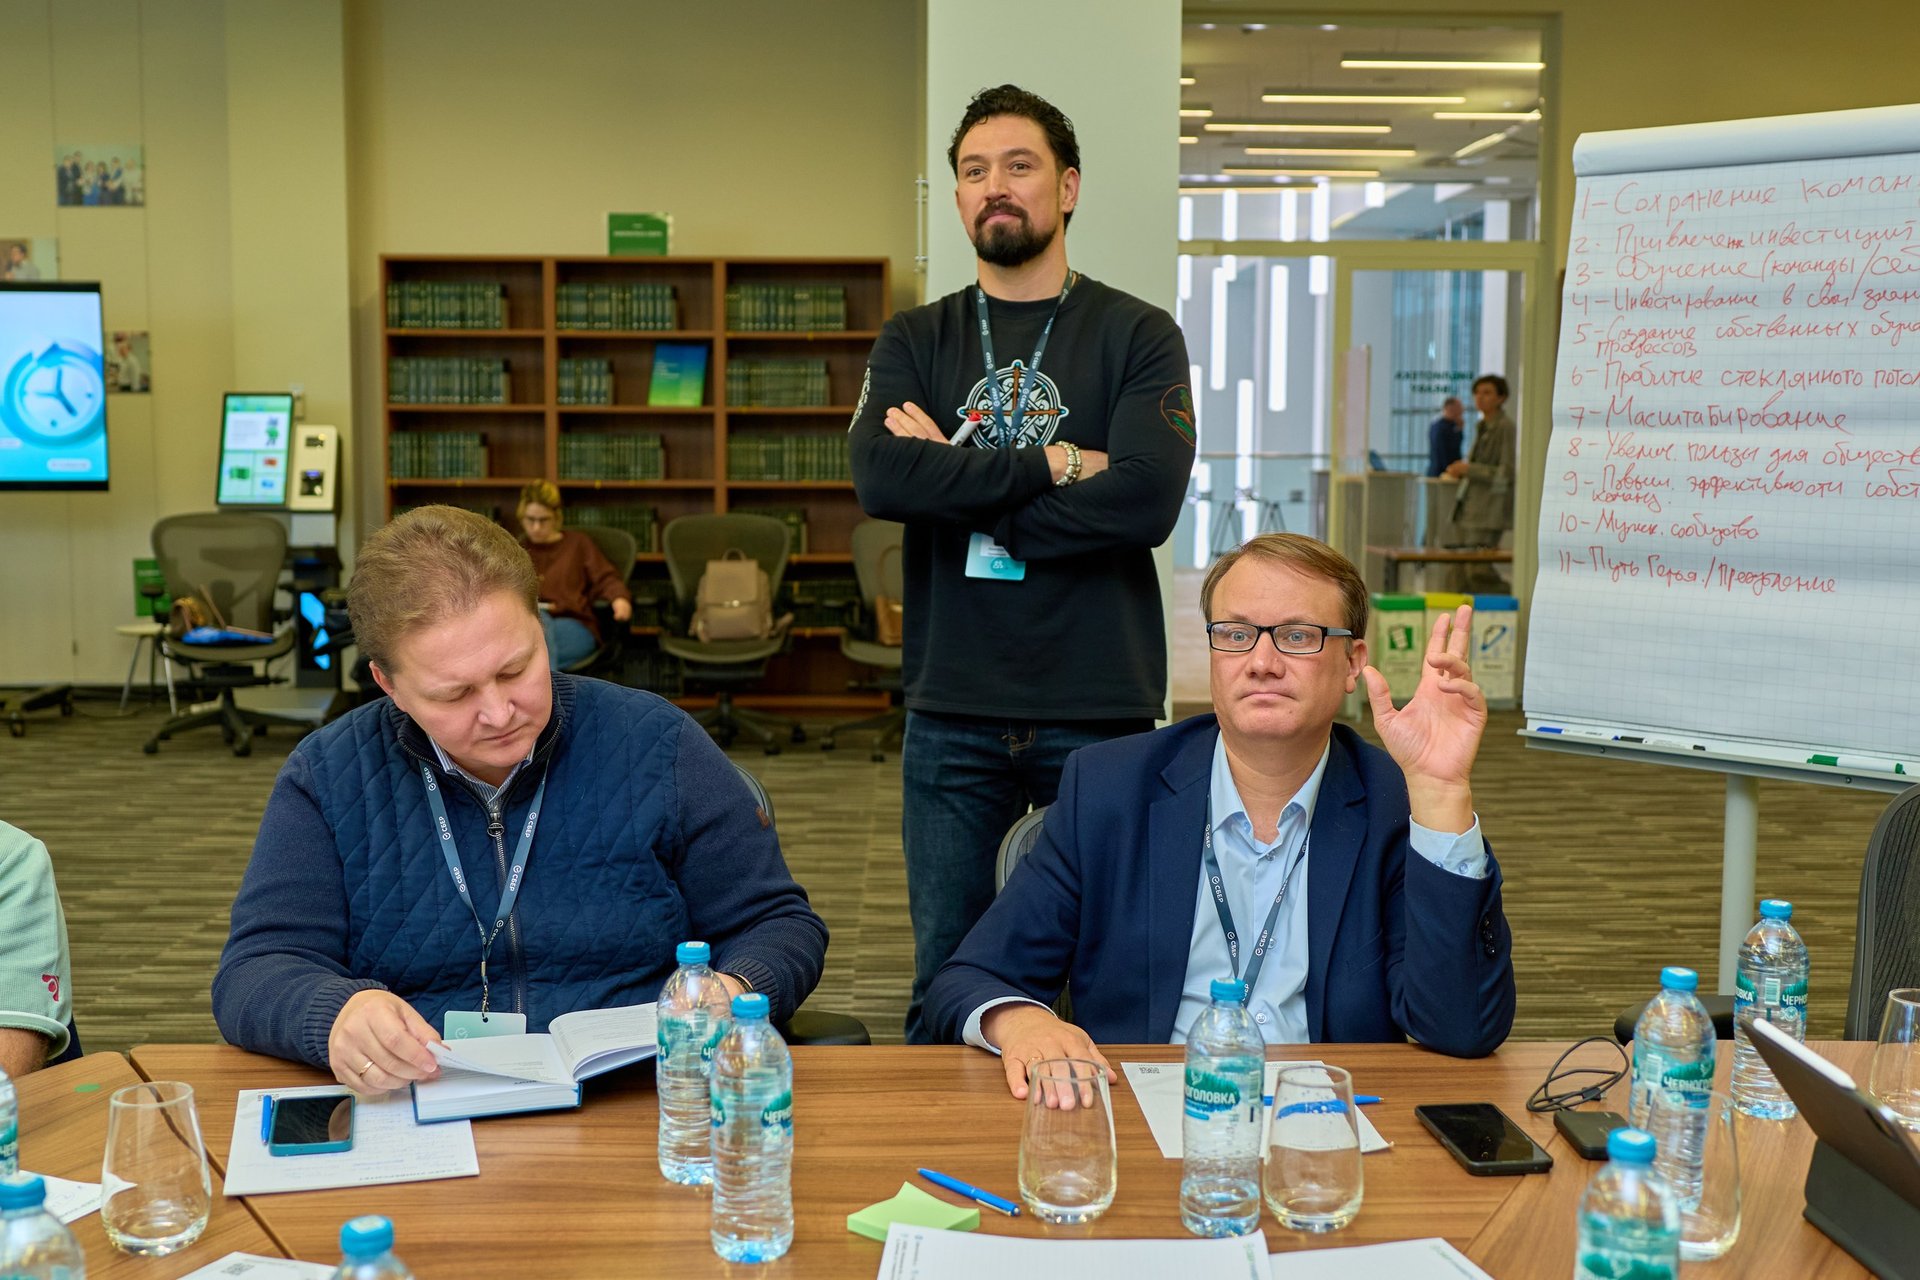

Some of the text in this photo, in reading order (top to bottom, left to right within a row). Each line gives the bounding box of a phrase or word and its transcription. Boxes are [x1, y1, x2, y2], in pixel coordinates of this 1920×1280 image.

[1614, 182, 1776, 227] Сохранение
[1783, 283, 1796, 305] в
[1716, 314, 1858, 338] собственных
[1721, 368, 1863, 391] стеклянного
[1766, 448, 1809, 473] для
[1687, 470, 1843, 499] эффективности
